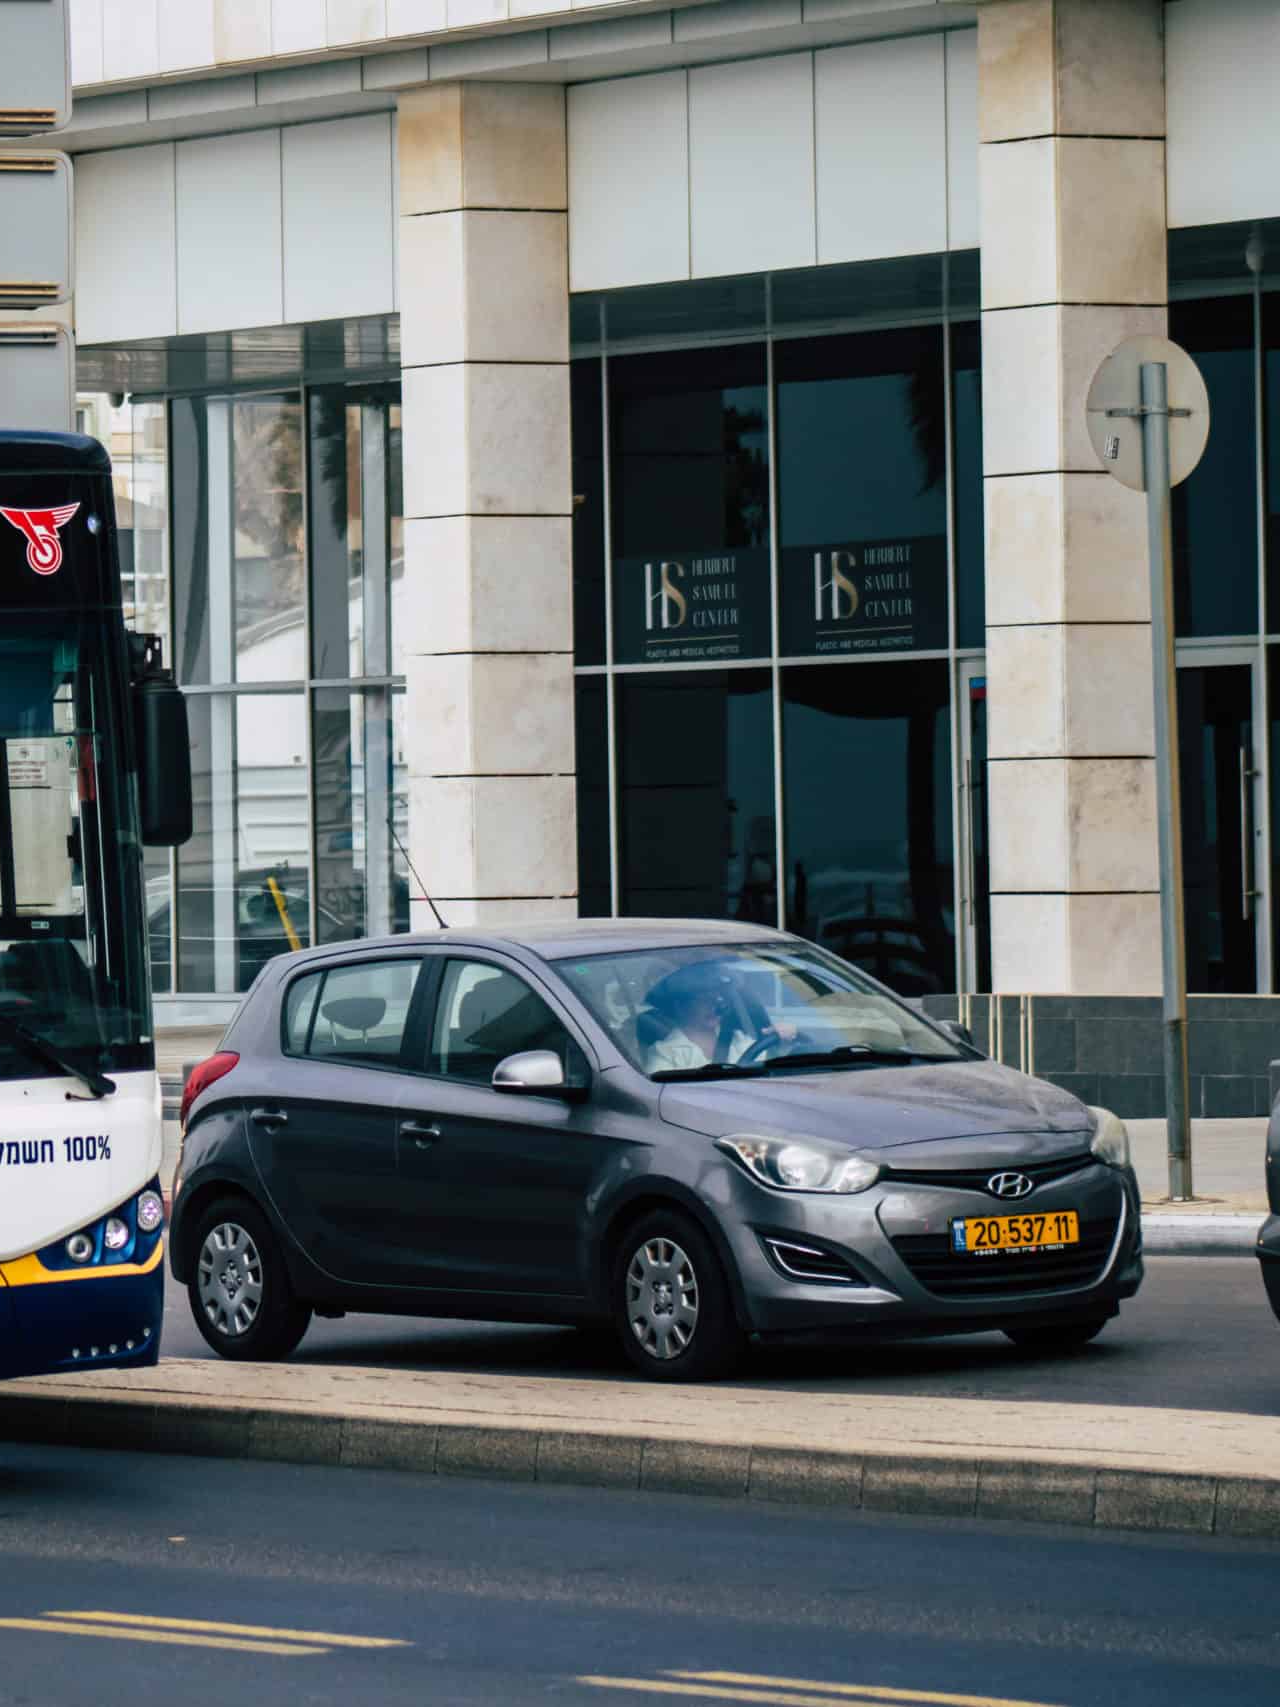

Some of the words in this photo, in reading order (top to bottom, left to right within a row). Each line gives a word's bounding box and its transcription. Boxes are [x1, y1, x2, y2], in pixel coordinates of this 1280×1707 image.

[864, 545, 911, 566] HERBERT
[691, 556, 736, 577] HERBERT
[691, 583, 737, 601] SAMUEL
[864, 571, 912, 592] SAMUEL
[692, 608, 738, 626] CENTER
[864, 598, 913, 618] CENTER
[63, 1134, 112, 1163] 100%
